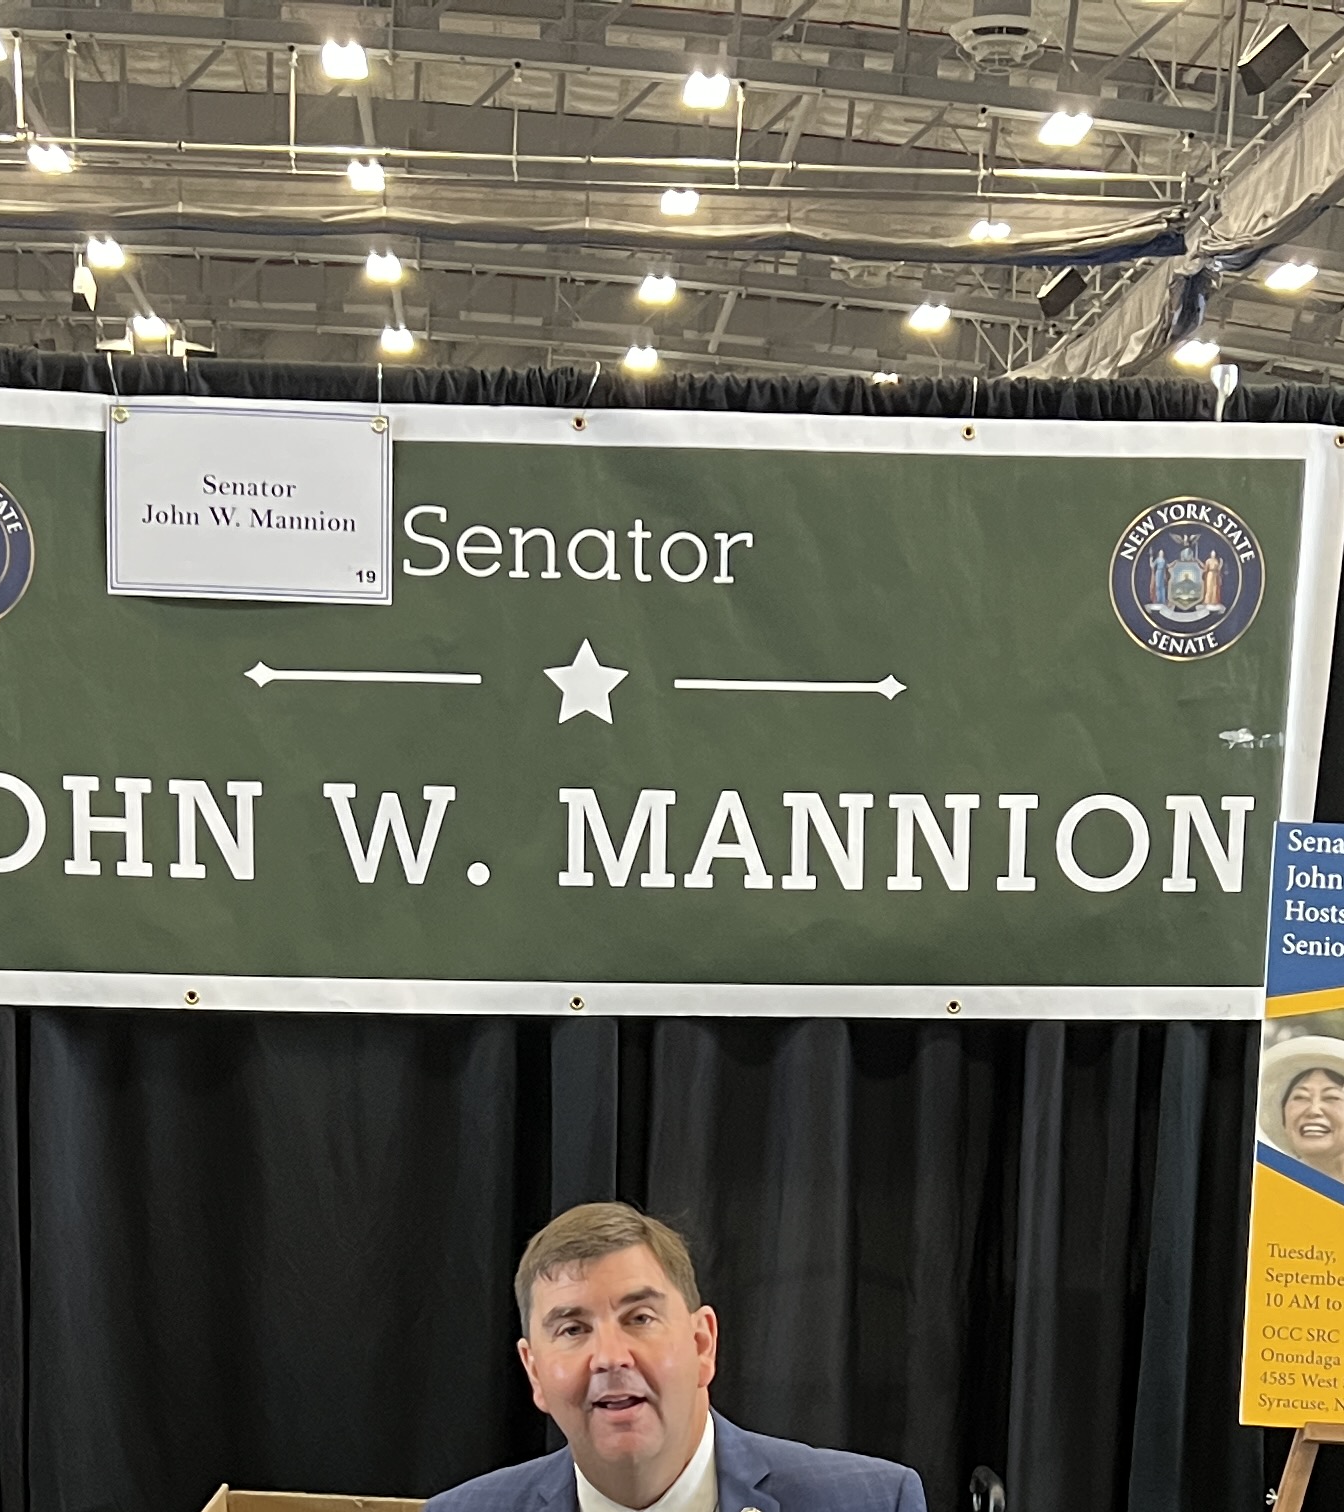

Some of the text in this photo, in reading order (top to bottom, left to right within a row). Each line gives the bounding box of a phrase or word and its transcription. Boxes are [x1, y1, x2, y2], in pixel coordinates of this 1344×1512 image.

[202, 473, 297, 498] Senator
[142, 504, 356, 532] John W. Mannion
[1120, 503, 1256, 563] NEW YORK STATE
[402, 505, 754, 585] Senator
[356, 570, 376, 584] 19
[1148, 630, 1219, 654] SENATE
[322, 782, 493, 888] W.
[557, 787, 1256, 895] MANNION
[1286, 865, 1343, 891] John
[1267, 1243, 1336, 1265] Tuesday,
[1265, 1293, 1283, 1307] 10
[1288, 1294, 1320, 1309] AM
[1326, 1297, 1342, 1311] to
[1262, 1325, 1302, 1341] OCC
[1306, 1328, 1340, 1343] SRC
[1261, 1348, 1341, 1370] Onondaga
[1260, 1371, 1295, 1386] 4585
[1302, 1373, 1337, 1389] West
[1258, 1393, 1329, 1412] Syracuse,
